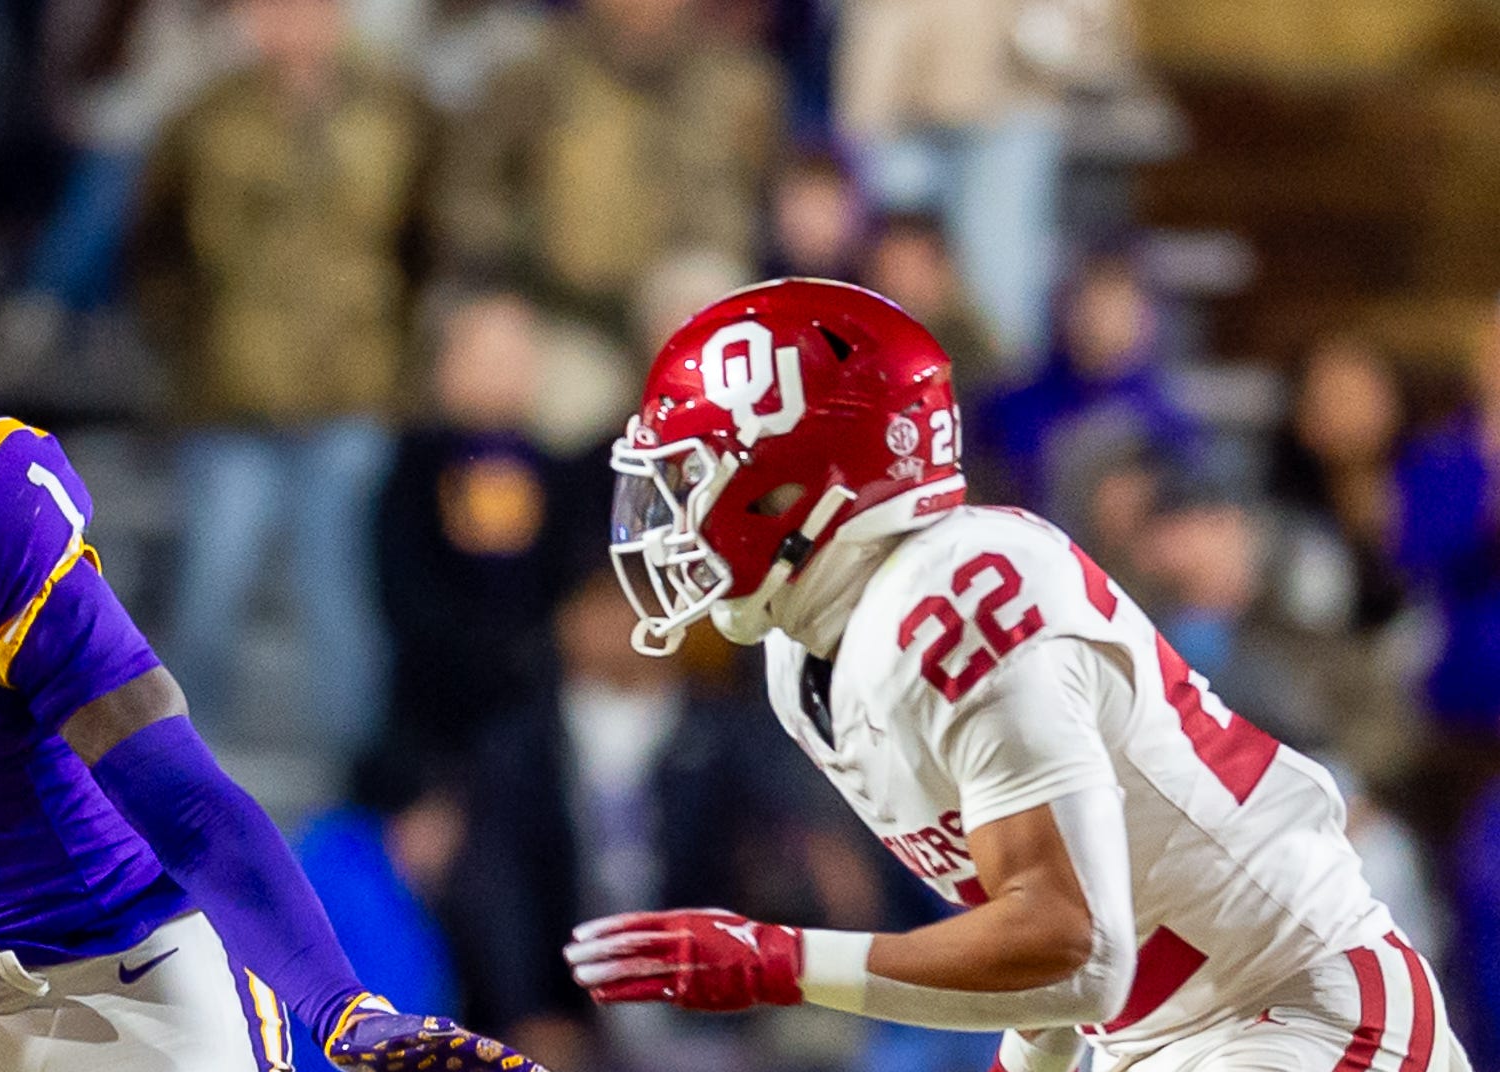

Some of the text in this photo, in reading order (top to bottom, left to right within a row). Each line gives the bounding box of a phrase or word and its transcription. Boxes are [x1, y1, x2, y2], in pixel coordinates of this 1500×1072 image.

[699, 319, 807, 449] OU
[929, 402, 963, 467] 2
[25, 460, 86, 534] 1
[897, 551, 1045, 704] 22
